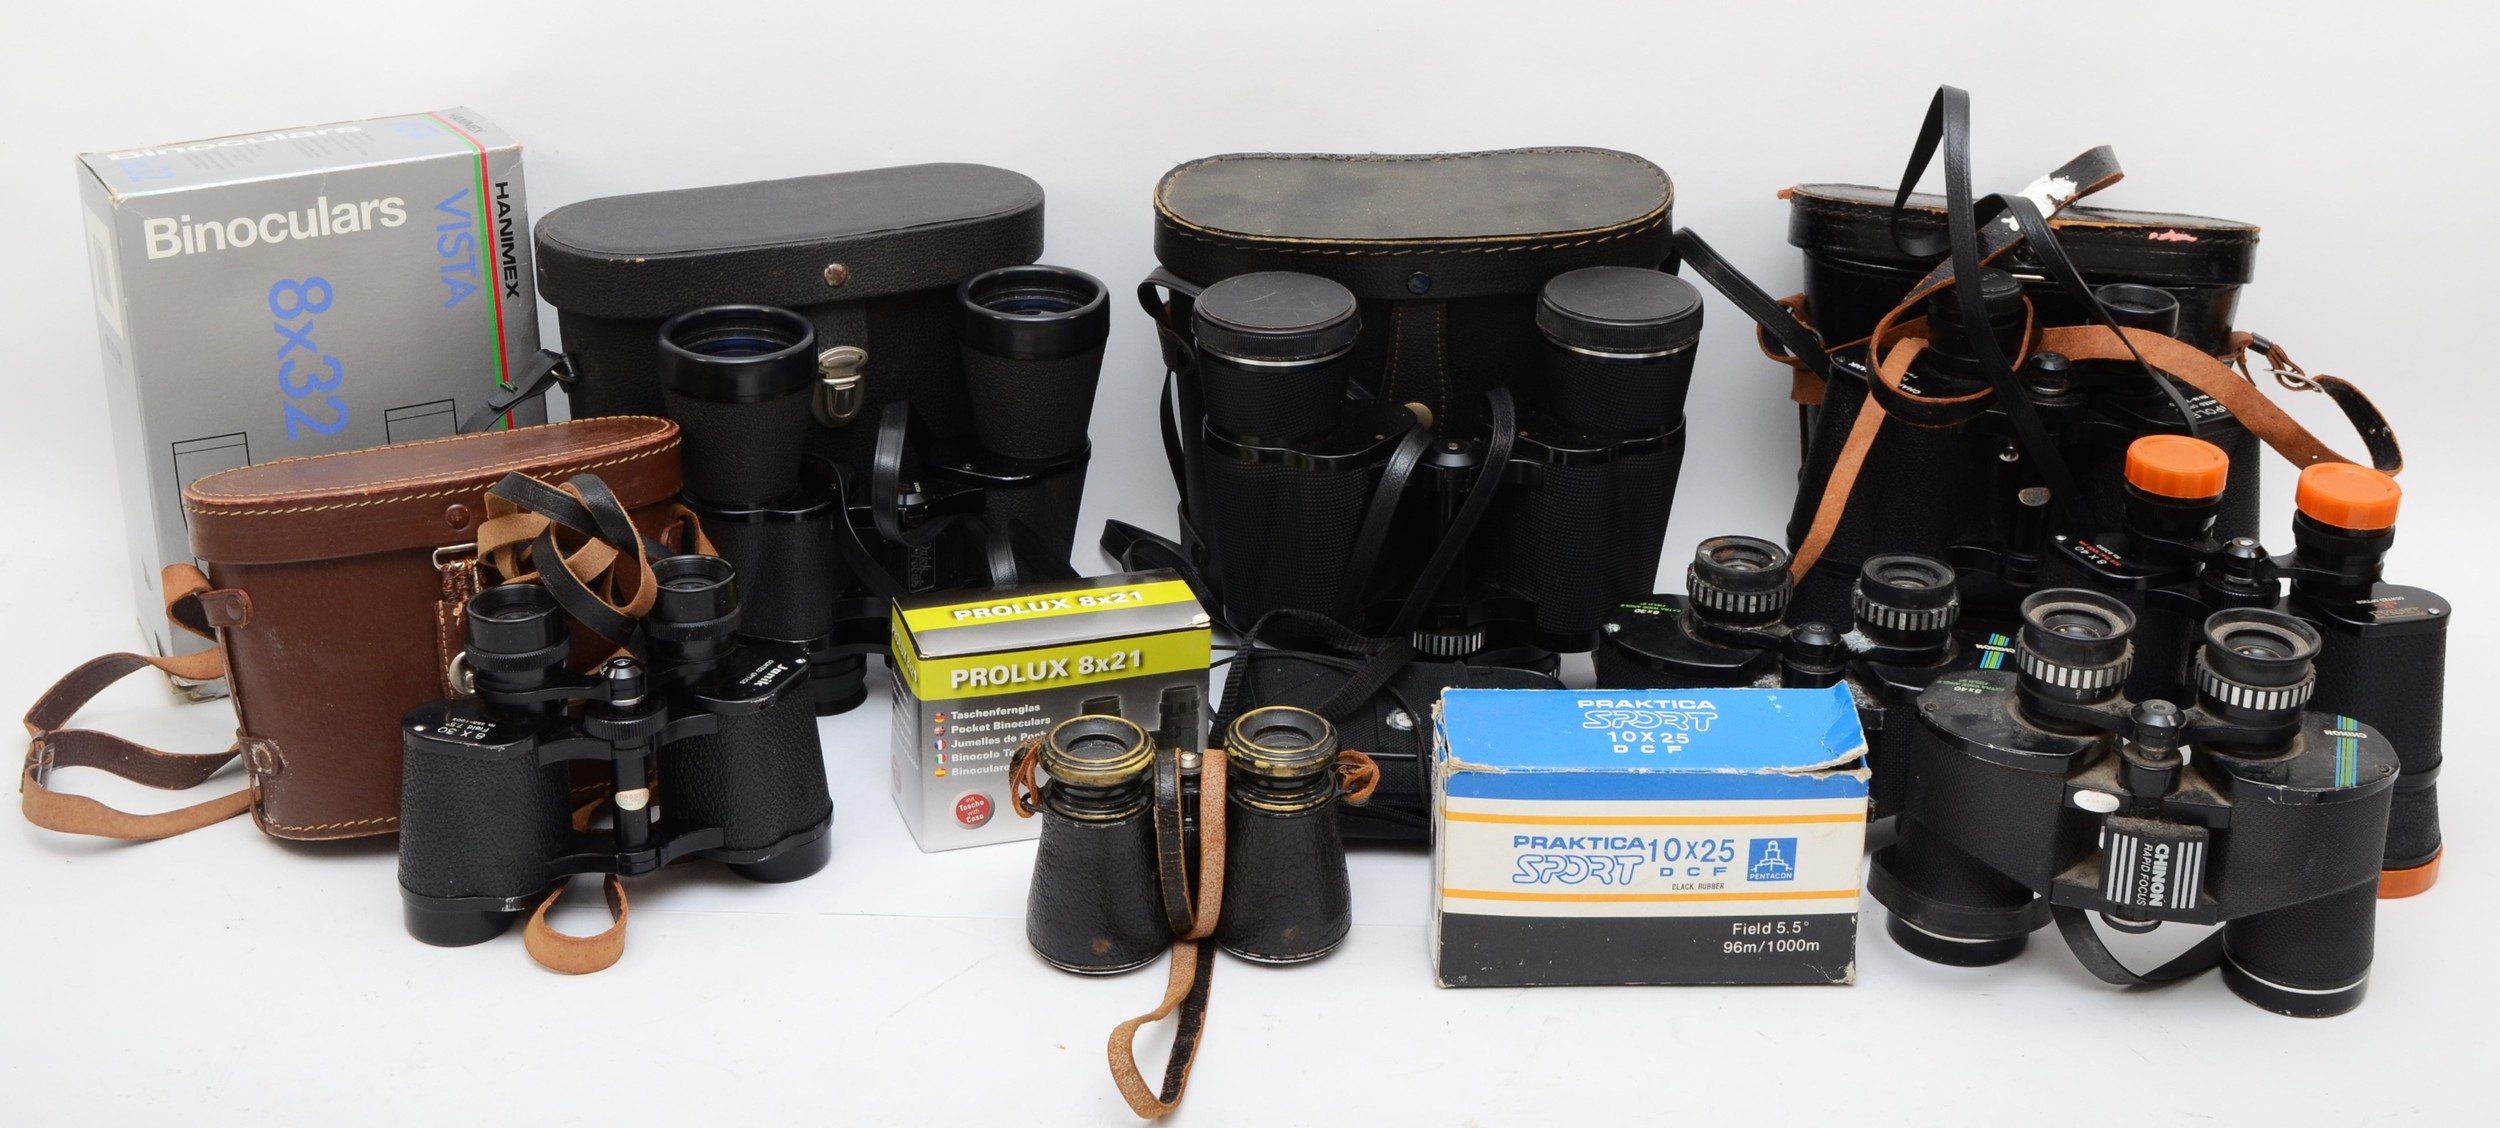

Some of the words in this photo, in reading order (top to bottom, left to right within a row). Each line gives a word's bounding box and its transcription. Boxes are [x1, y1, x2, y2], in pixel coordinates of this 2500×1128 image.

[143, 196, 408, 260] Binoculars
[434, 187, 479, 310] VISTA
[495, 181, 520, 300] HANIMEX
[268, 276, 349, 442] 8x32
[953, 598, 1072, 621] PROLUX
[1078, 591, 1143, 607] 8x21
[1975, 643, 2015, 653] CHINON
[754, 663, 789, 687] Janik
[951, 658, 1069, 689] PROLUX
[1078, 649, 1141, 675] 8x21
[951, 704, 1041, 720] Taschenfernglas
[1577, 699, 1717, 710] PRAKTICA
[466, 724, 490, 733] Field
[951, 723, 990, 734] Pocket
[993, 717, 1051, 730] Binoculars
[1582, 710, 1719, 732] SPORT
[951, 737, 1001, 748] Jumelles
[1004, 734, 1017, 743] de
[2323, 729, 2368, 739] CHINON
[951, 750, 1000, 762] Binocolo
[959, 800, 985, 812] Tasche
[966, 814, 984, 824] Case
[1513, 835, 1646, 850] PRAKTICA
[2141, 843, 2153, 873] RAPID
[1512, 853, 1645, 886] SPORT
[1749, 872, 1793, 880] PENTACON
[2149, 843, 2170, 907] CHINON
[1697, 881, 1725, 891] RUBBER
[2136, 873, 2150, 907] FOCUS
[1732, 922, 1771, 936] Field
[1776, 921, 1810, 935] 5.5°
[1723, 939, 1820, 955] 96m/1000m
